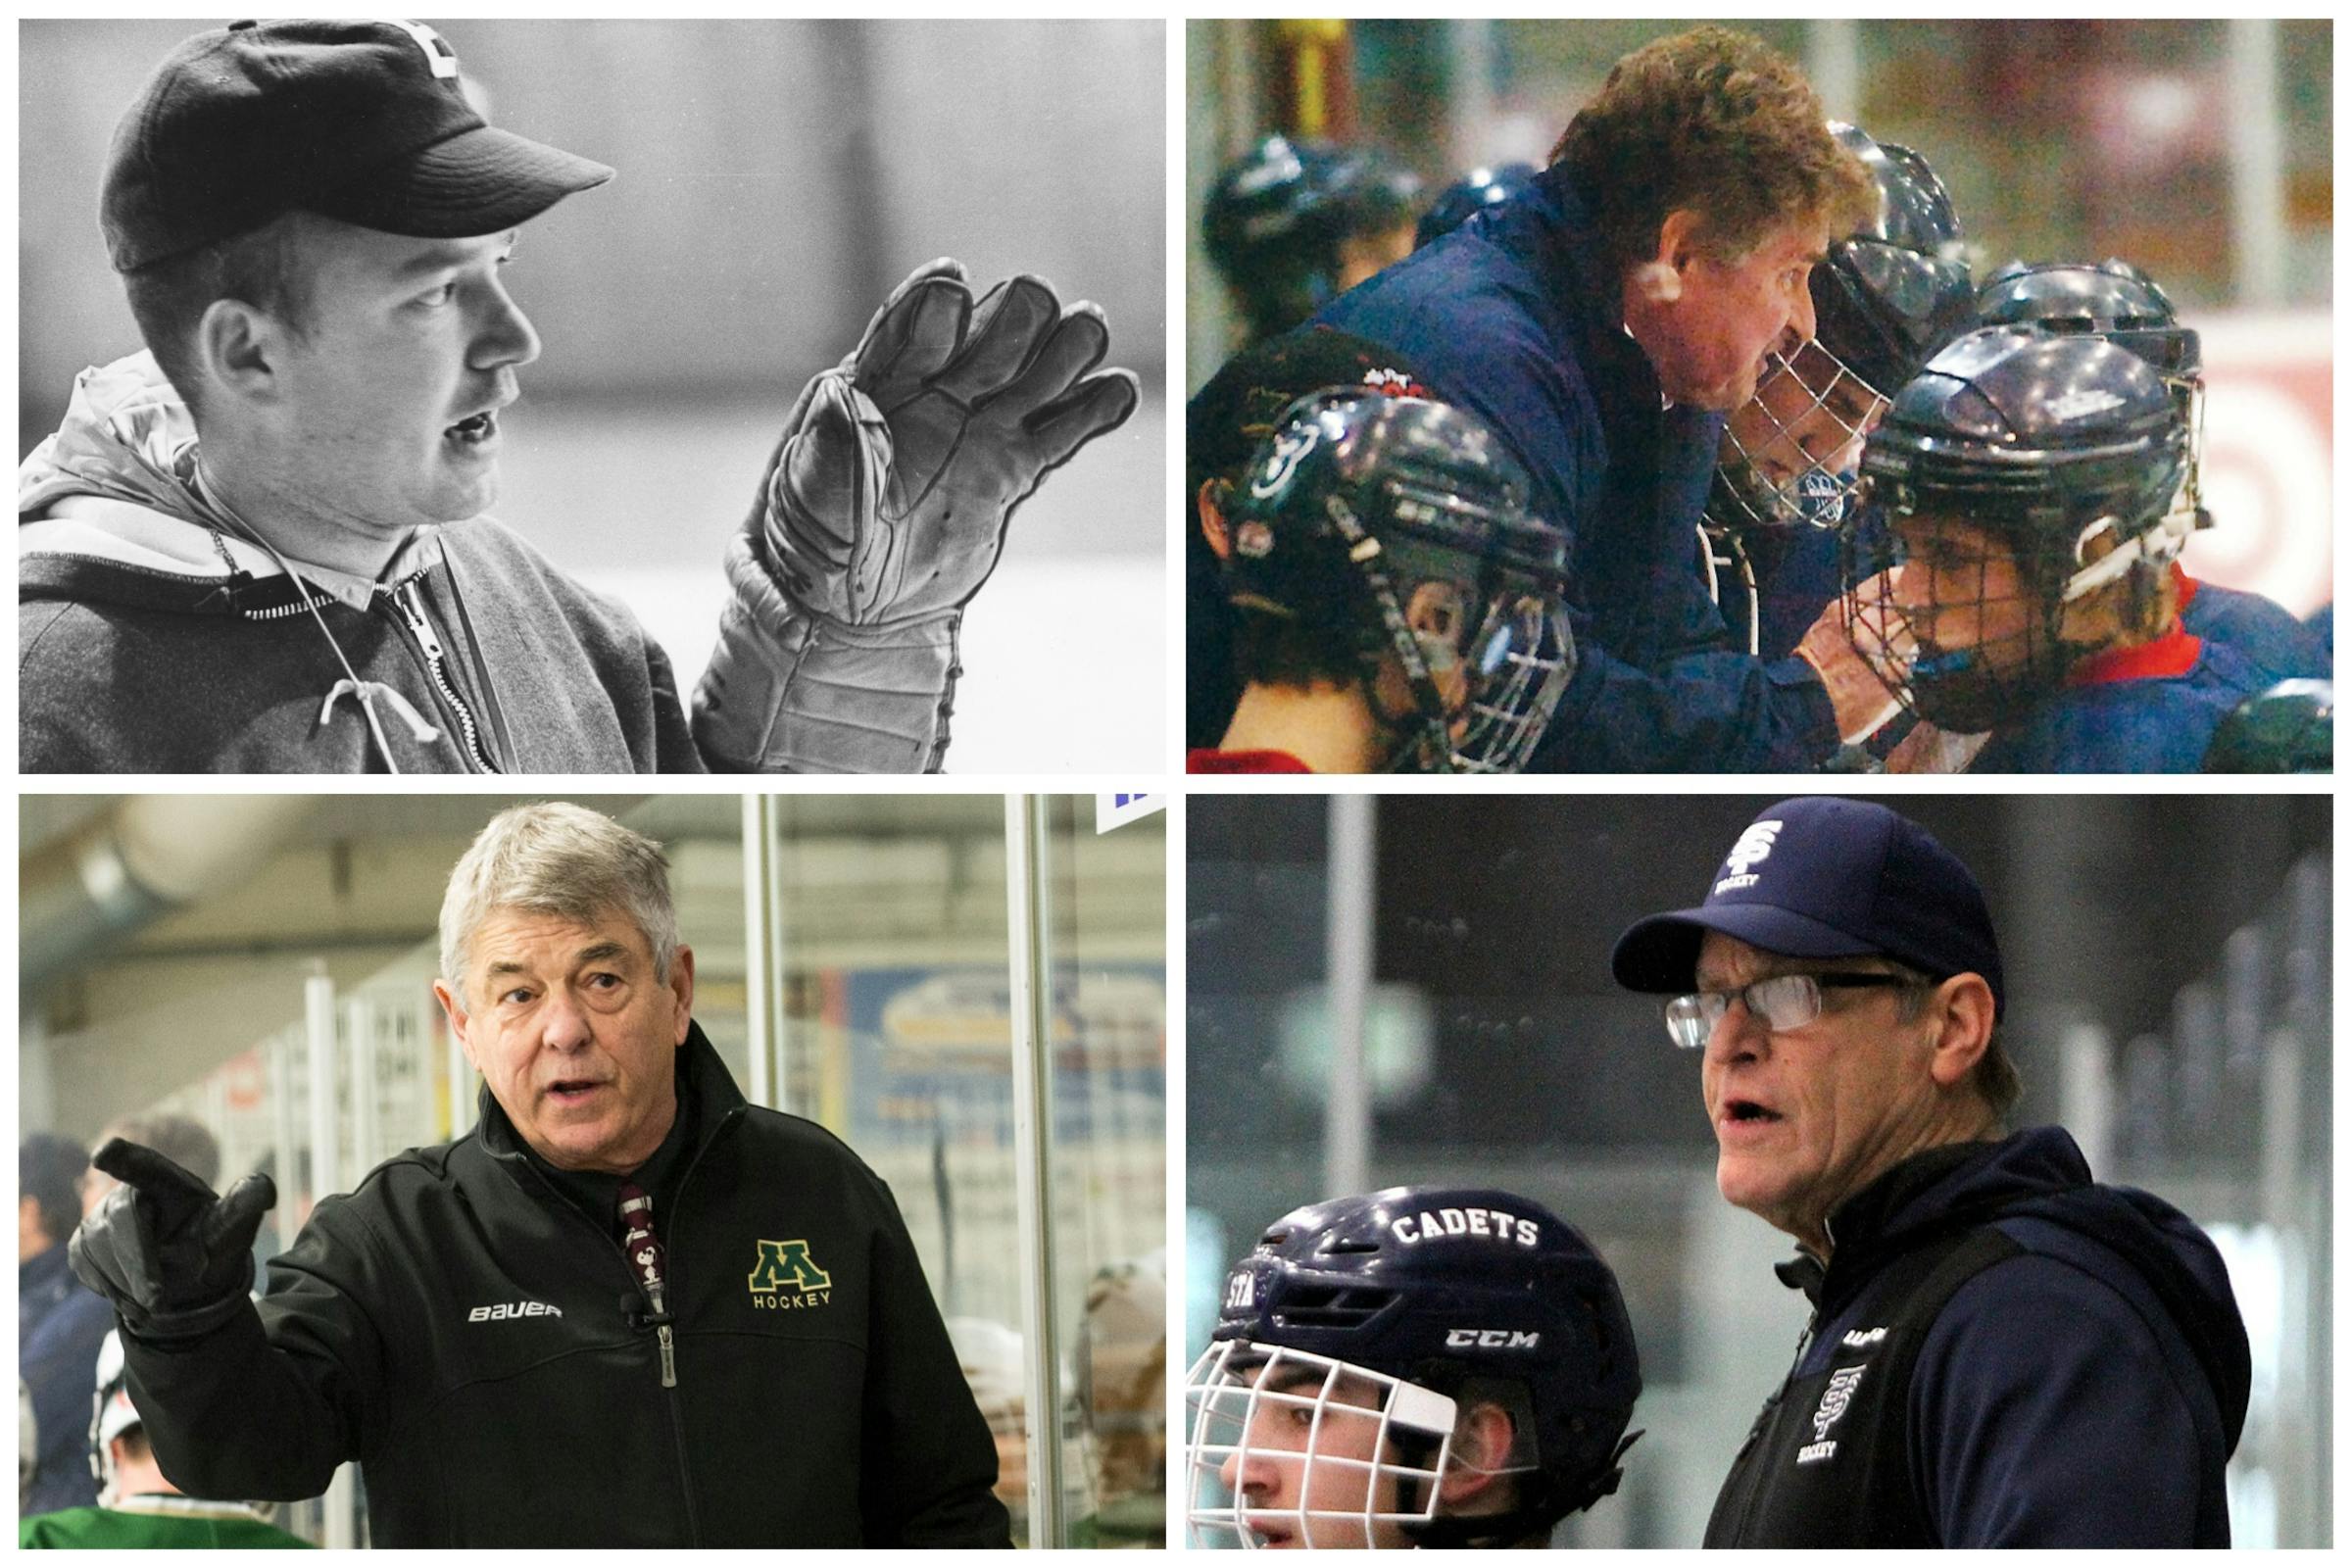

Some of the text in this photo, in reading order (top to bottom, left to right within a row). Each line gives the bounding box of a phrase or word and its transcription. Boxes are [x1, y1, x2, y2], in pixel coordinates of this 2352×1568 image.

[1392, 1207, 1539, 1247] CADETS
[748, 1239, 832, 1293] M
[754, 1291, 831, 1309] HOCKEY
[1226, 1272, 1254, 1308] STA
[467, 1301, 564, 1322] BAUER
[1446, 1329, 1541, 1348] CCM
